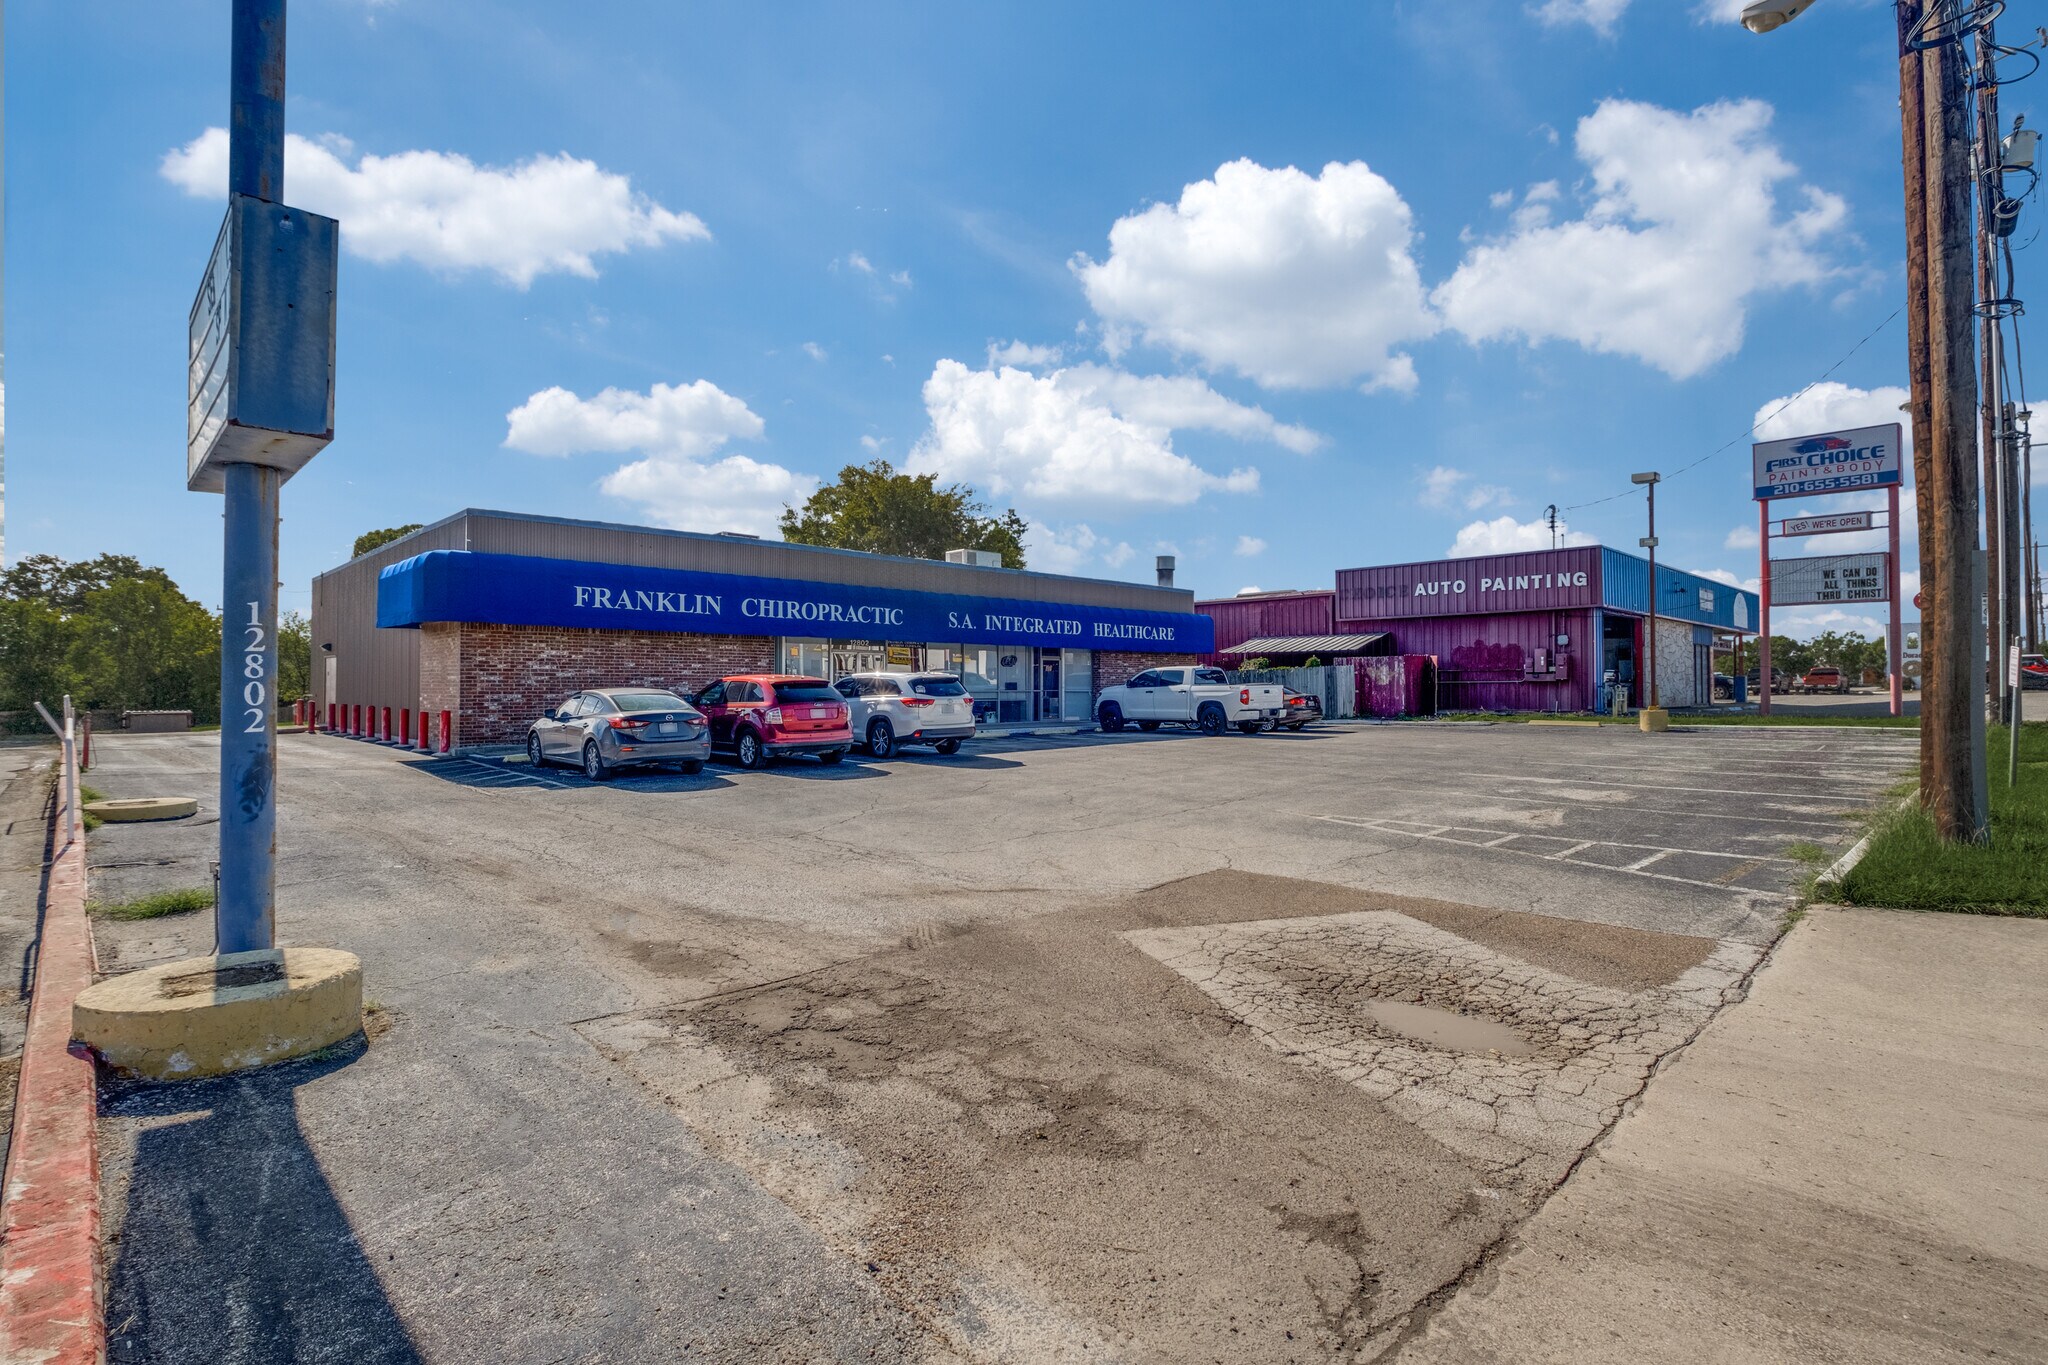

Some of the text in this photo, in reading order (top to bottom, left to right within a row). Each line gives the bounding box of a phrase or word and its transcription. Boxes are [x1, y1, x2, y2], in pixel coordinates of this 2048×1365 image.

[1766, 445, 1885, 473] FIRST CHOICE
[1790, 517, 1862, 532] YES! WE'RE OPEN
[1823, 567, 1877, 579] WE CAN DO
[1415, 580, 1466, 596] AUTO
[1481, 572, 1588, 592] PAINTING
[1824, 578, 1877, 590] ALL THINGS
[1817, 589, 1881, 600] THRU CHRIST
[573, 585, 1175, 640] FRANKLIN CHIROPRACTIC S.A. INTEGRATED HEALTHCARE
[244, 601, 266, 733] 12802
